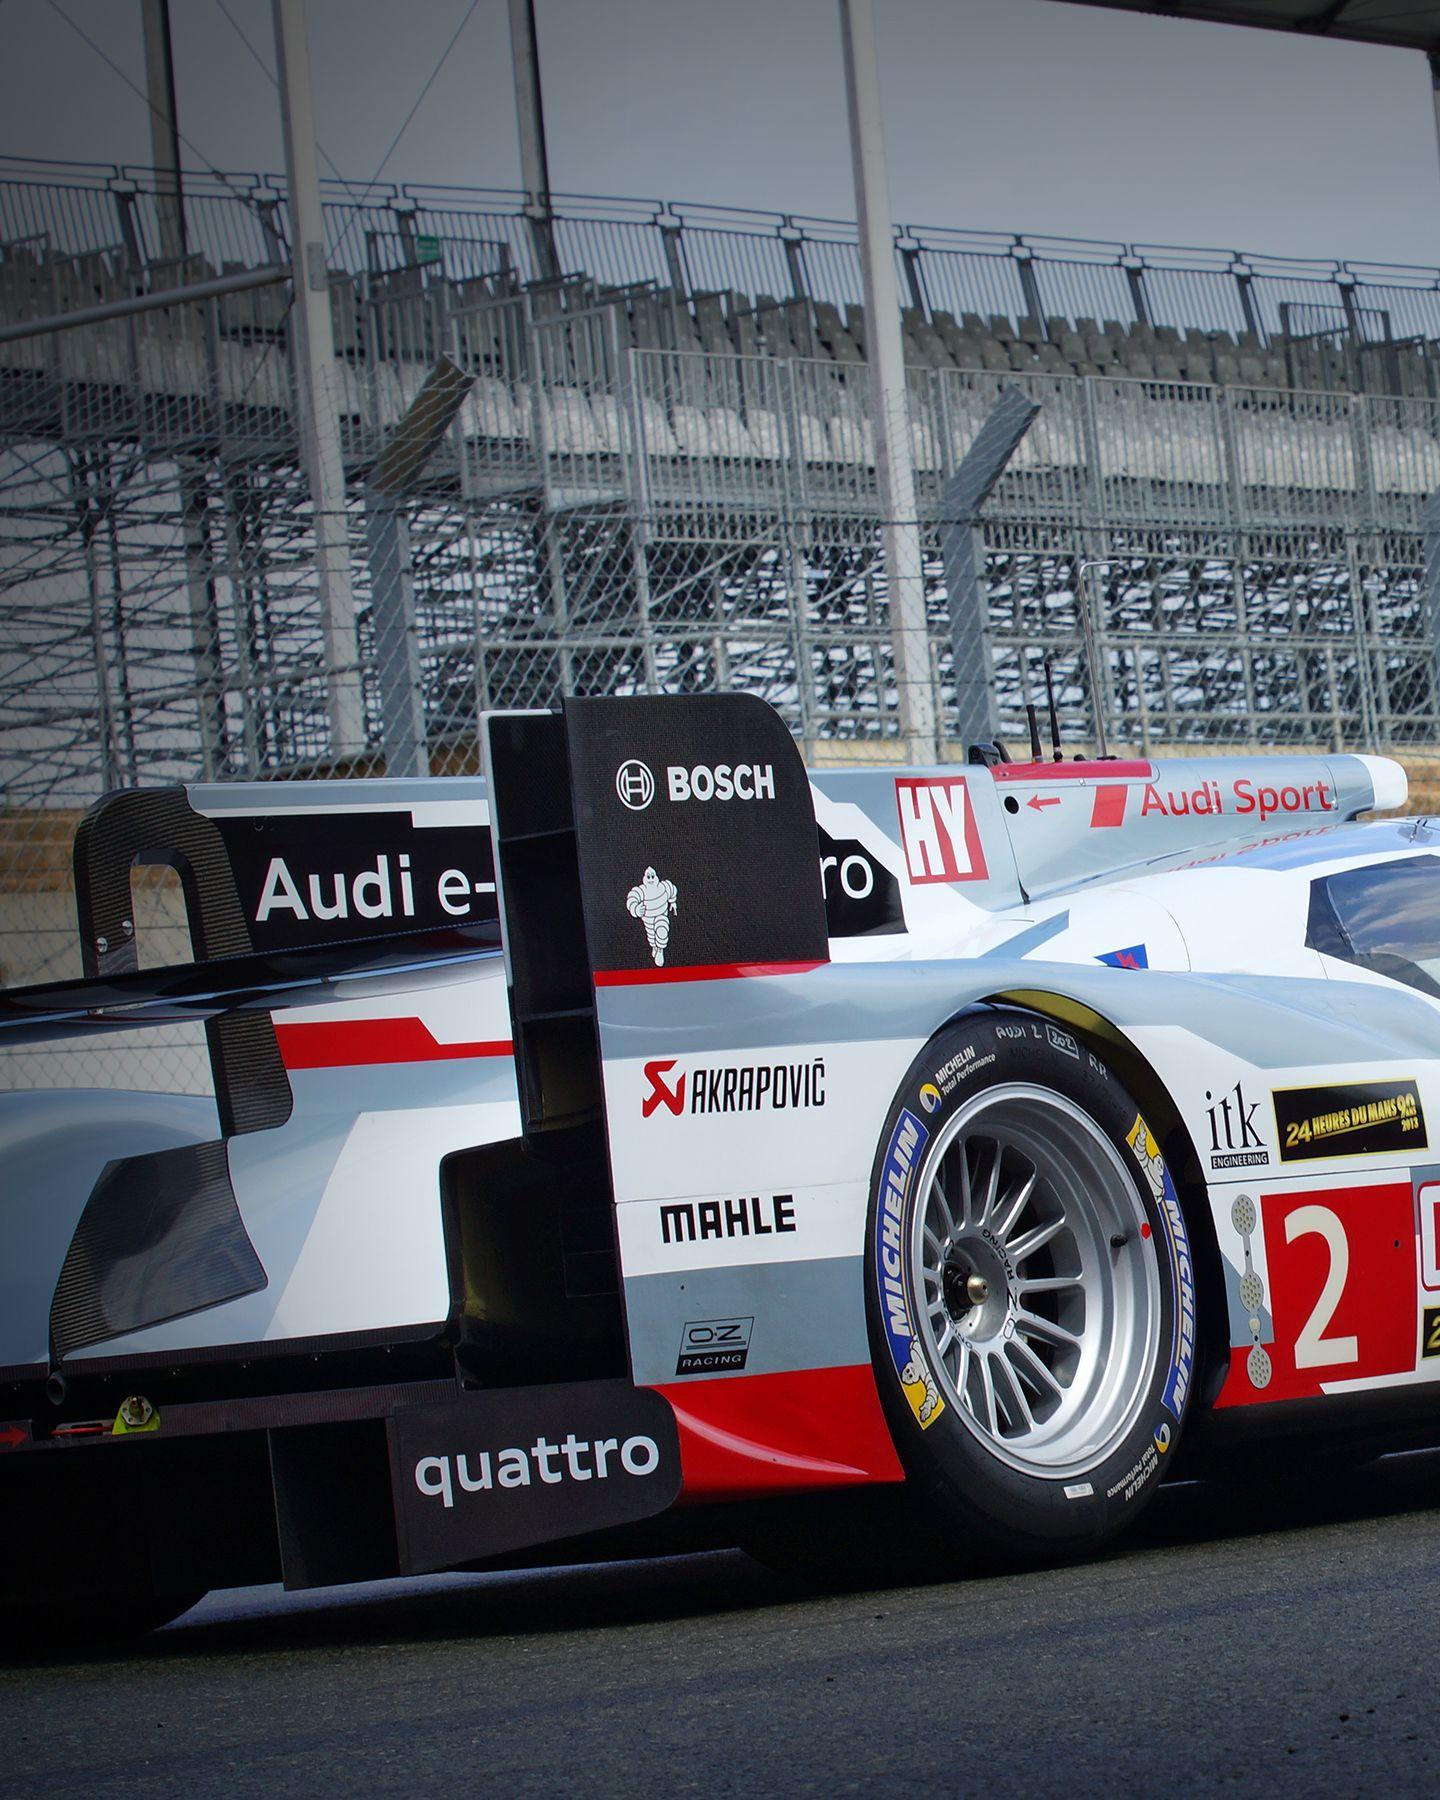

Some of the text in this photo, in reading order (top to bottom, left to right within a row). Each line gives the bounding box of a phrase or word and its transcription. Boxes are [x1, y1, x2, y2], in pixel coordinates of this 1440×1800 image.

[667, 764, 775, 801] BOSCH
[1141, 779, 1332, 821] Audi Sport
[898, 784, 972, 877] HY
[255, 854, 415, 921] Audi
[934, 1046, 976, 1085] MICHELIN
[941, 1053, 996, 1096] Total Performance
[1205, 1080, 1267, 1151] itk
[1286, 1119, 1313, 1148] 24
[1312, 1110, 1351, 1135] HEURES
[1350, 1106, 1368, 1124] DU
[1367, 1098, 1398, 1121] MANS
[1401, 1116, 1420, 1132] 2013
[1212, 1153, 1268, 1169] ENGINEERING
[660, 1195, 797, 1244] MAHLE
[882, 1116, 919, 1337] MICHELIN
[982, 1228, 1015, 1280] RACING
[1165, 1199, 1194, 1417] MICHELIN
[1284, 1204, 1359, 1369] 2
[682, 1354, 742, 1368] RACING
[415, 1434, 660, 1508] quattro
[1124, 1454, 1158, 1501] MICHELIN
